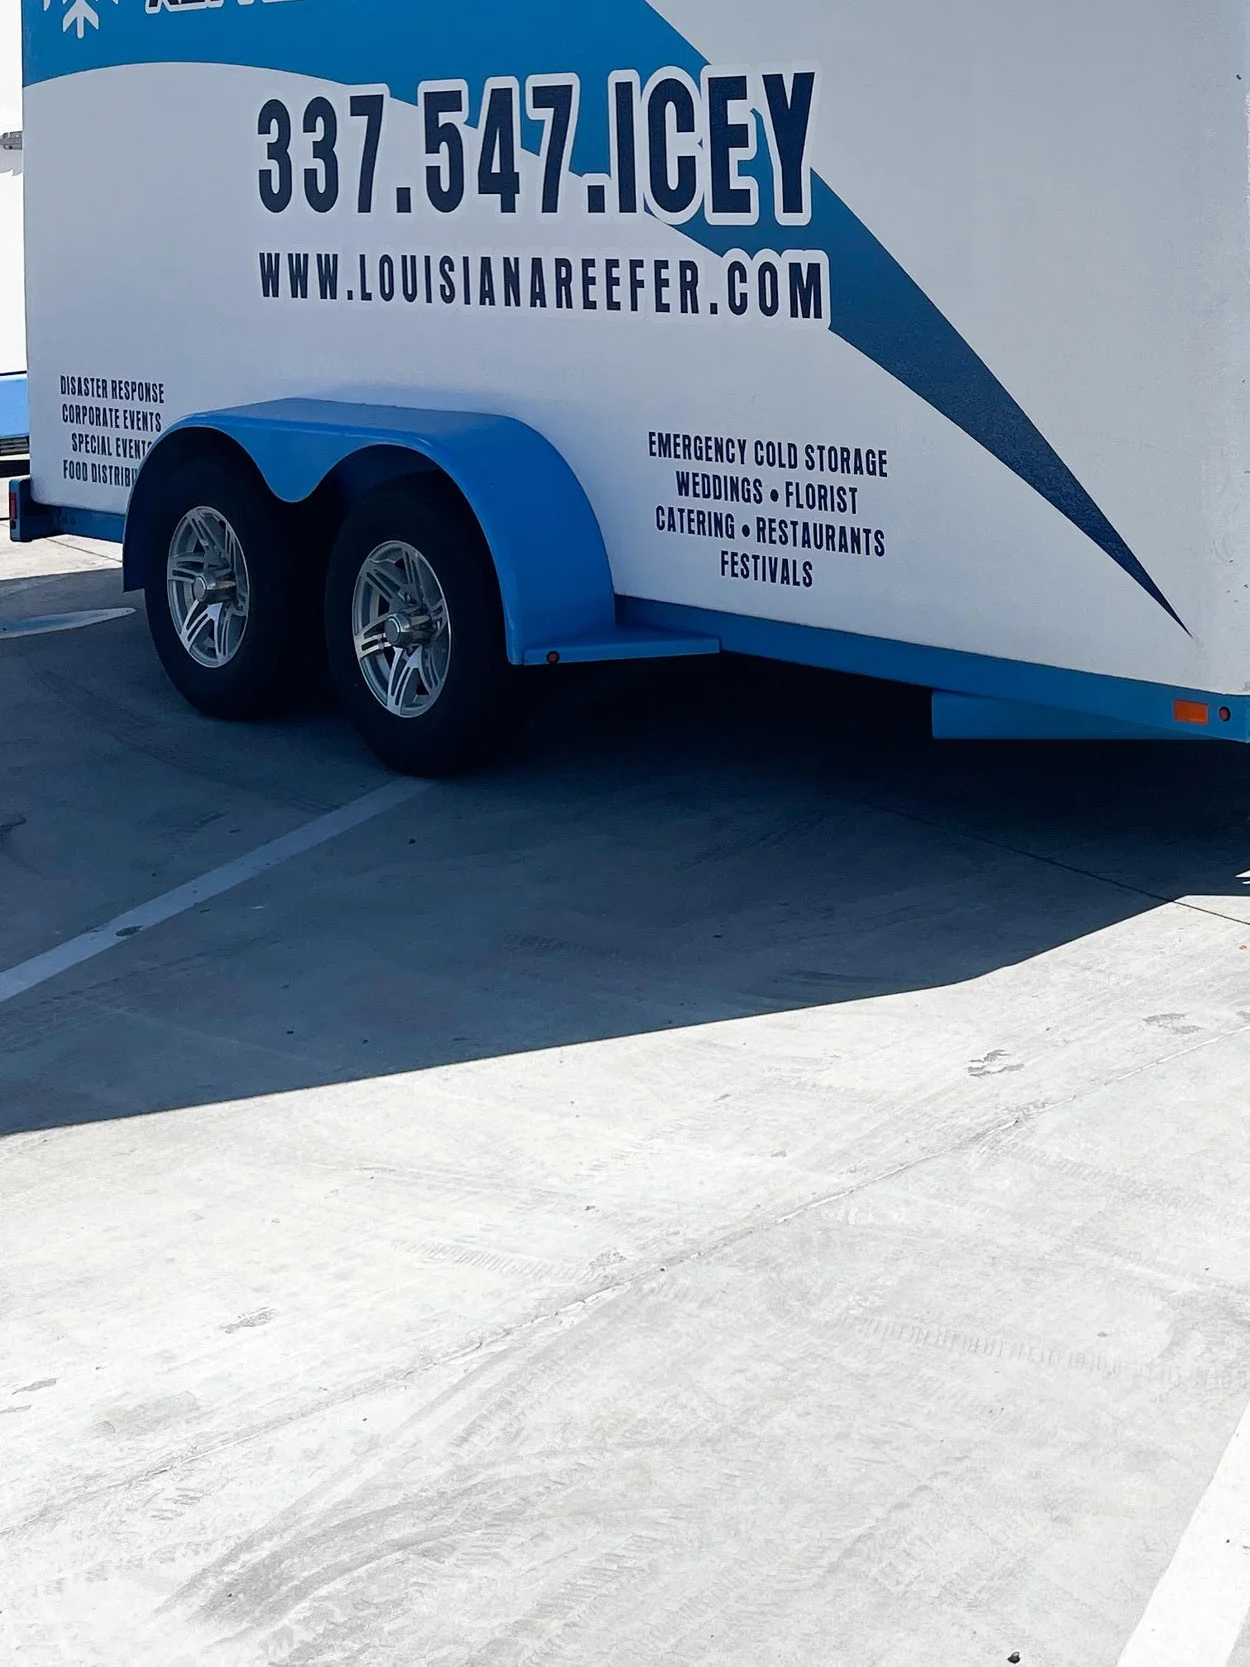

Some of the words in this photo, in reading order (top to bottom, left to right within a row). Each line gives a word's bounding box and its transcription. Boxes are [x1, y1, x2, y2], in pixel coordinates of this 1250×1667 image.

[257, 71, 815, 214] 337.547.ICEY
[258, 252, 824, 319] WWW.LOUISIANAREEFER.COM
[60, 375, 108, 399] DISASTER
[111, 380, 164, 404] RESPONSE
[62, 403, 120, 429] CORPORATE
[123, 409, 162, 433] EVENTS
[72, 433, 112, 457] SPECIAL
[648, 431, 747, 465] EMERGENCY
[754, 440, 798, 470] COLD
[804, 443, 888, 478] STORAGE
[63, 459, 88, 482] FOOD
[675, 470, 763, 505] WEDDINGS
[785, 481, 858, 514] FLORIST
[655, 505, 735, 540] CATERING
[756, 516, 886, 557] RESTAURANTS
[720, 550, 813, 588] FESTIVALS
